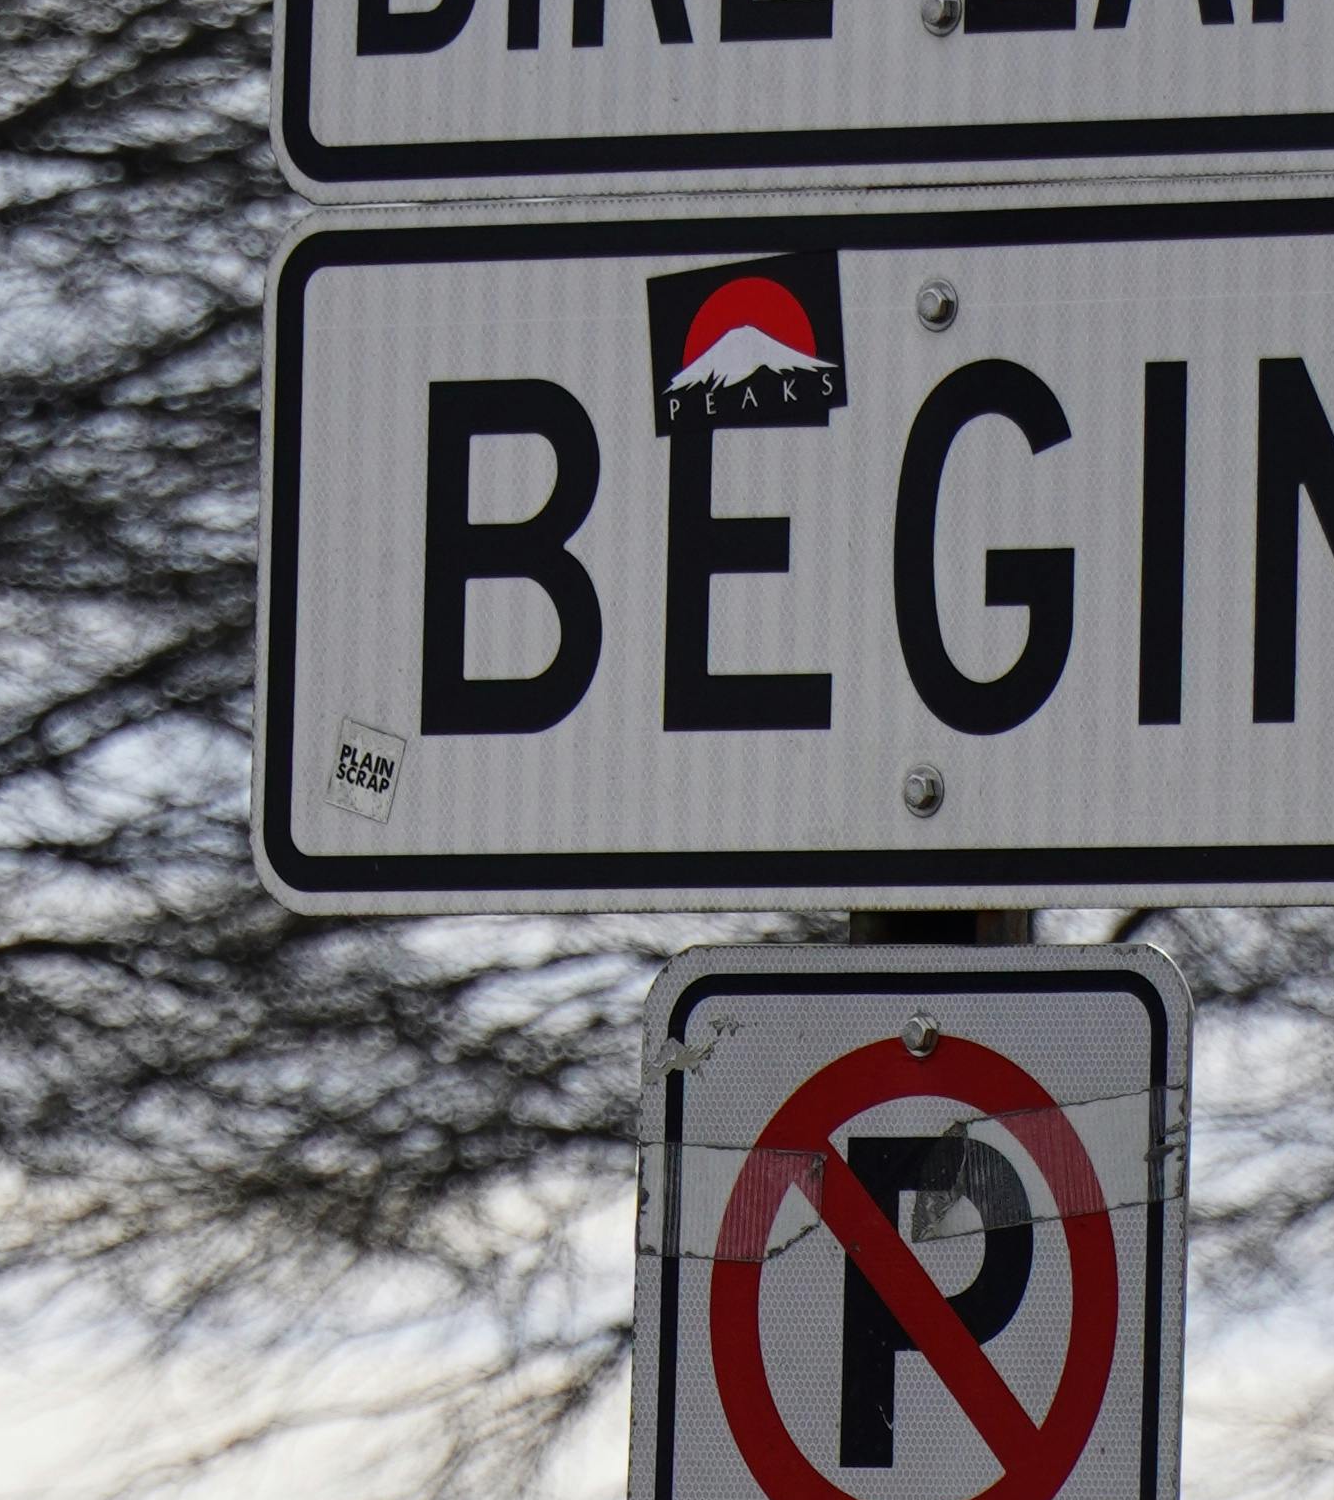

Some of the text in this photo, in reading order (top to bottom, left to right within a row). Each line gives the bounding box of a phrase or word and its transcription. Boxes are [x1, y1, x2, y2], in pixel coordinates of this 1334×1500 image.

[669, 372, 834, 421] PEAKS
[336, 763, 391, 794] SCRAP
[339, 743, 395, 779] PLAIN
[839, 1136, 1034, 1468] P
